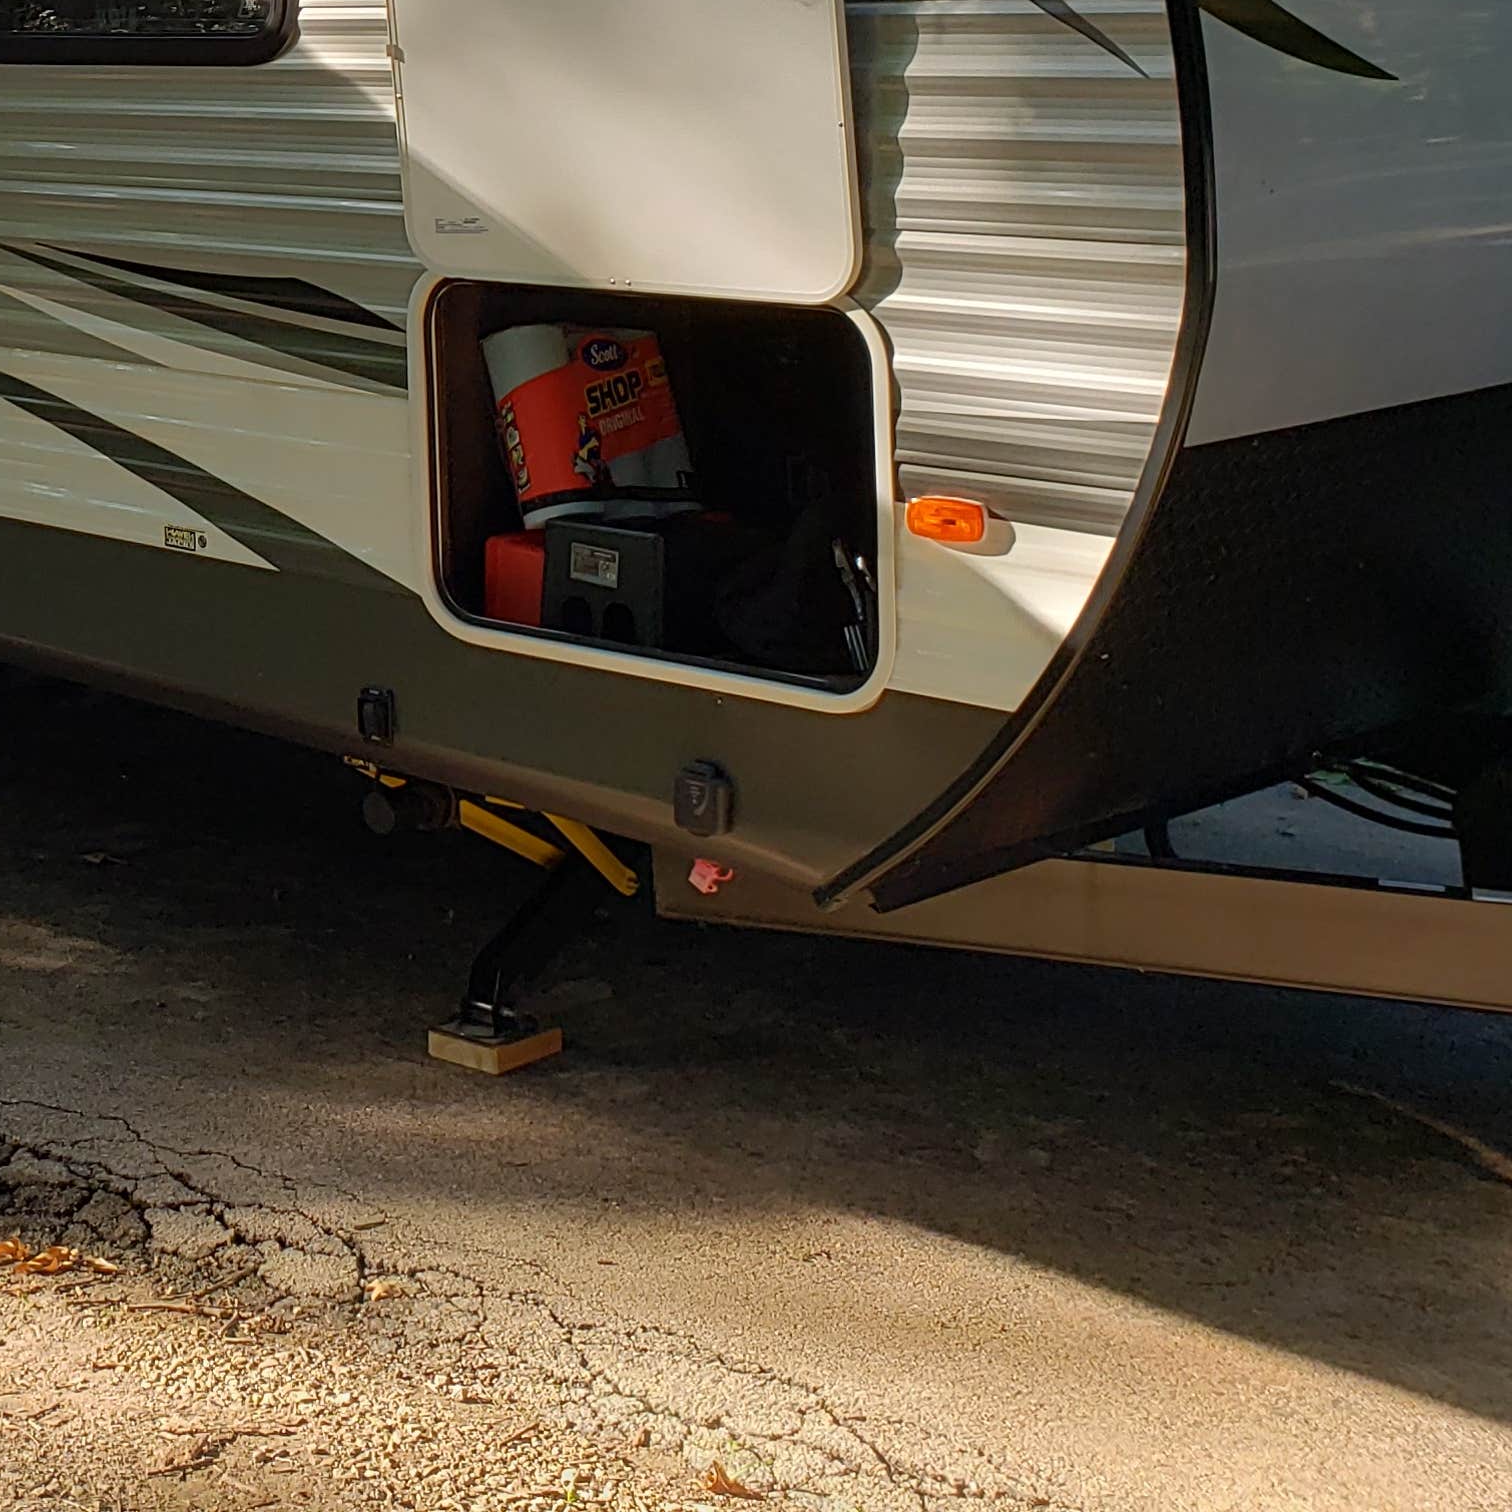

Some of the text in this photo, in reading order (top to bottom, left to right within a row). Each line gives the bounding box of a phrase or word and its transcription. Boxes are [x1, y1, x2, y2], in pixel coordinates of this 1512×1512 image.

[590, 344, 619, 365] Scott
[585, 369, 643, 419] SHOP
[599, 407, 645, 436] ORIGINAL
